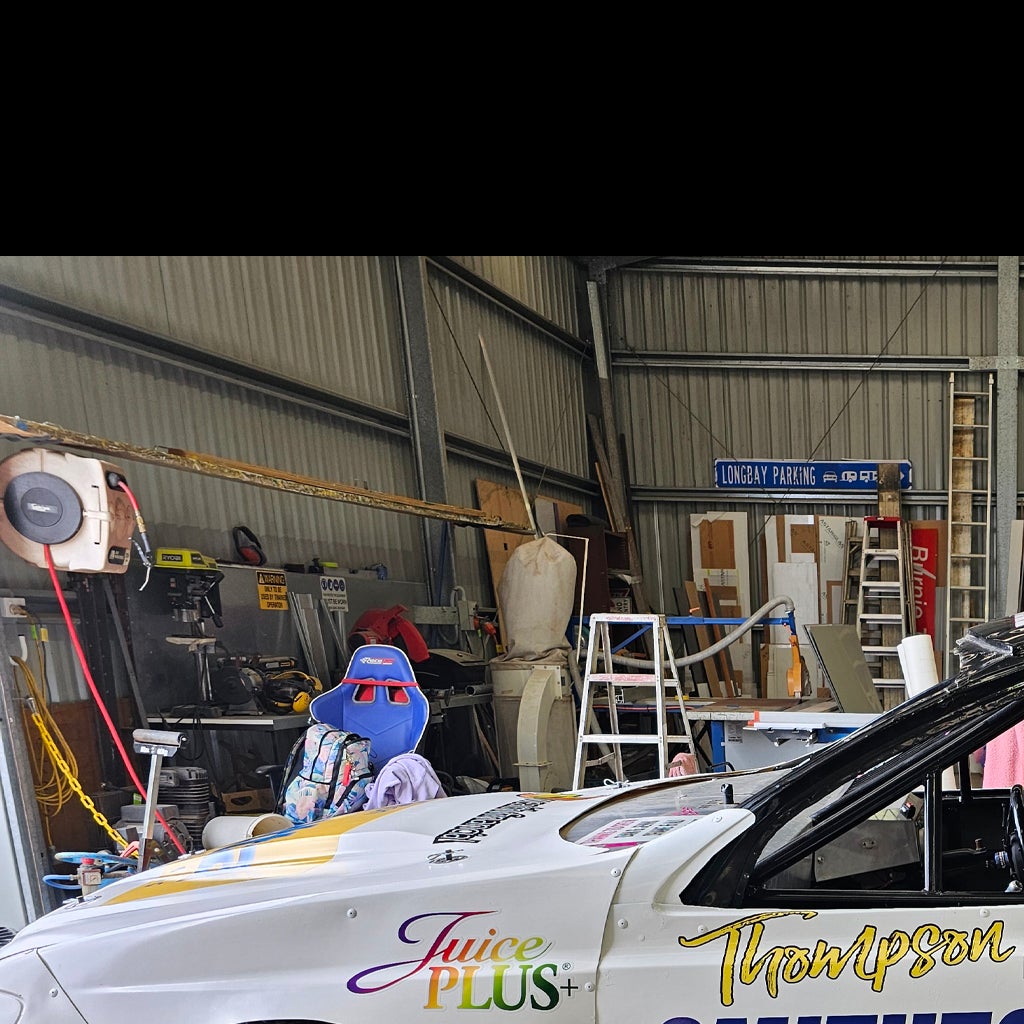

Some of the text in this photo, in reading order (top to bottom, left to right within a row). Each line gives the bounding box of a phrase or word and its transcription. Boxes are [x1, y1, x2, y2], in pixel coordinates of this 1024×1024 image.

[722, 465, 816, 486] LONGBAY PARKING
[264, 573, 285, 585] WARNING
[347, 911, 552, 994] Juice
[678, 911, 1016, 1006] Thompson
